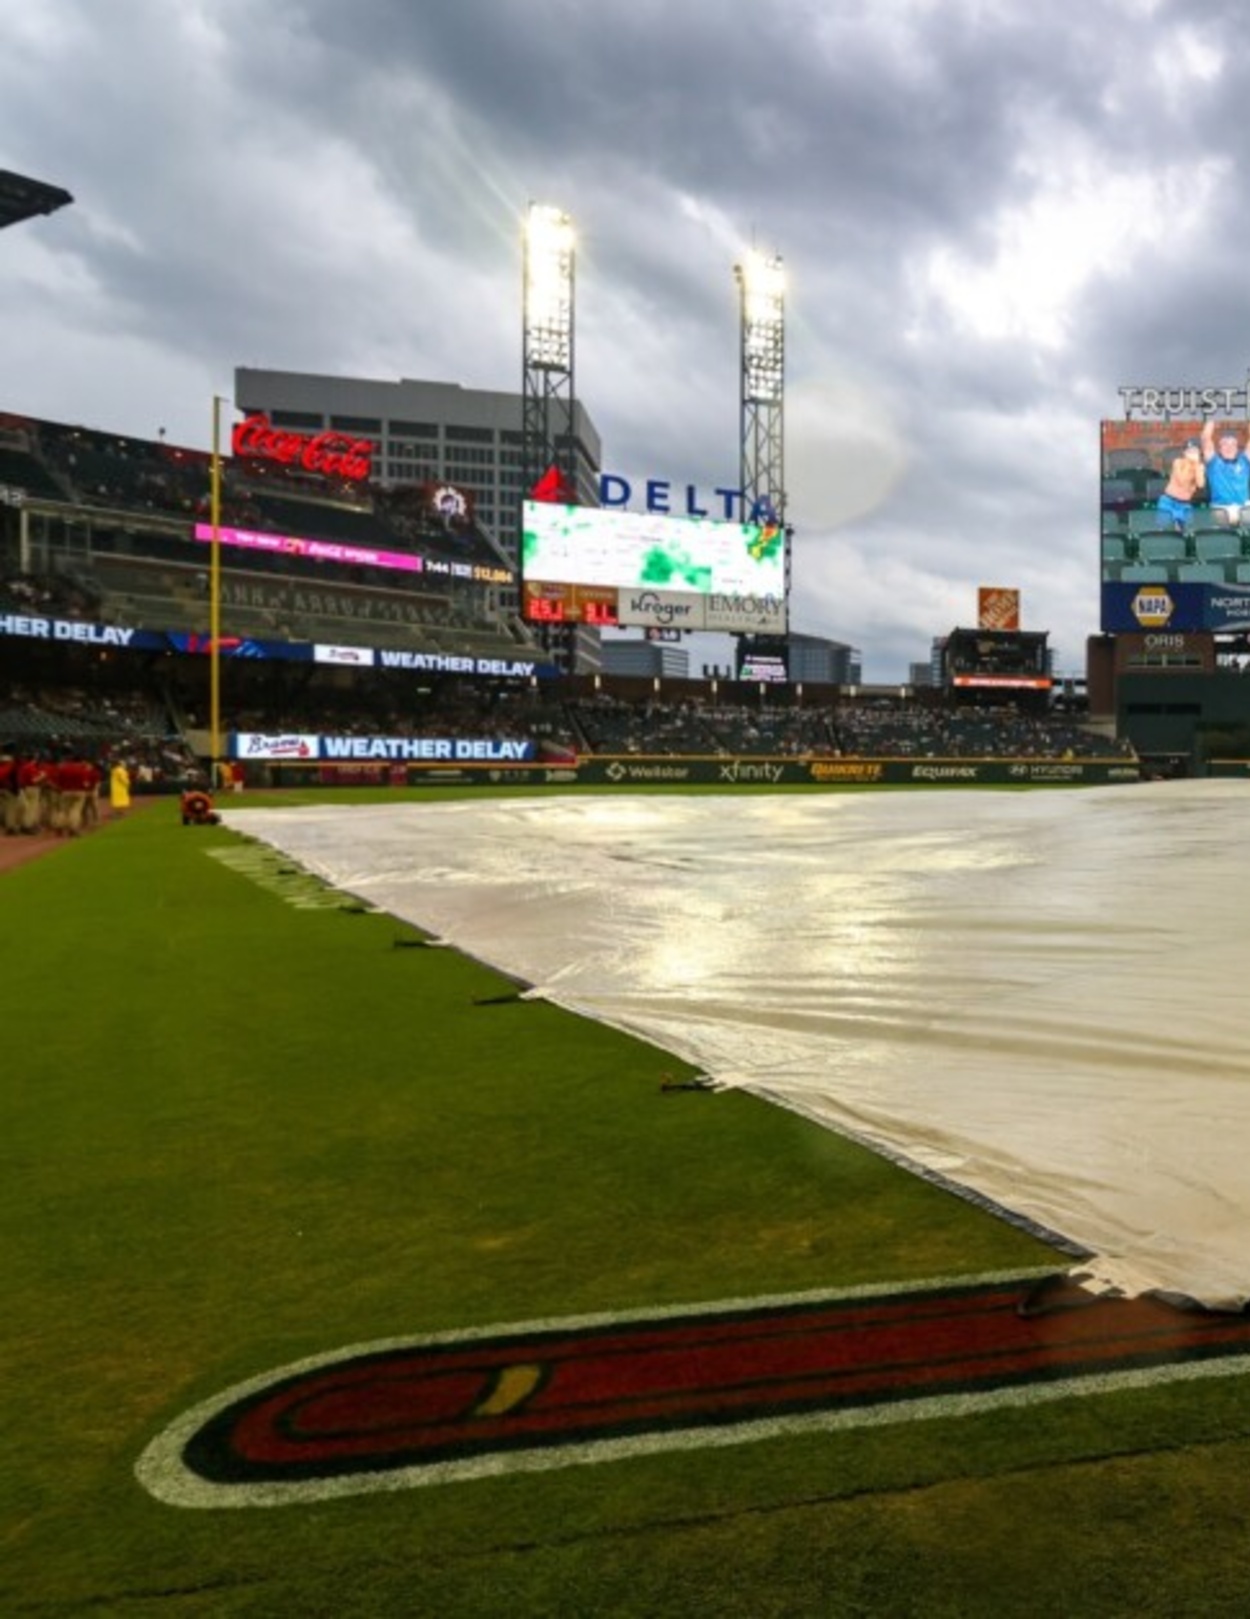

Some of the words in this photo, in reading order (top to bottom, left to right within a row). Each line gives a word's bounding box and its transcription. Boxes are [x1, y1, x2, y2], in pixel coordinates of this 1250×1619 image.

[1118, 388, 1238, 415] TRUIST
[232, 412, 375, 481] Coca-Cola
[599, 474, 776, 525] DELTA
[631, 592, 692, 624] Kroger
[709, 593, 783, 616] EMORY
[1135, 596, 1170, 615] NAPA
[54, 619, 134, 646] DELAY
[380, 650, 475, 672] WEATHER
[477, 656, 535, 677] DELAY
[324, 737, 450, 759] WEATHER
[454, 740, 529, 760] DELAY
[629, 763, 689, 778] Wellstar
[720, 760, 784, 782] xfinity
[912, 765, 978, 779] EQUIFAX
